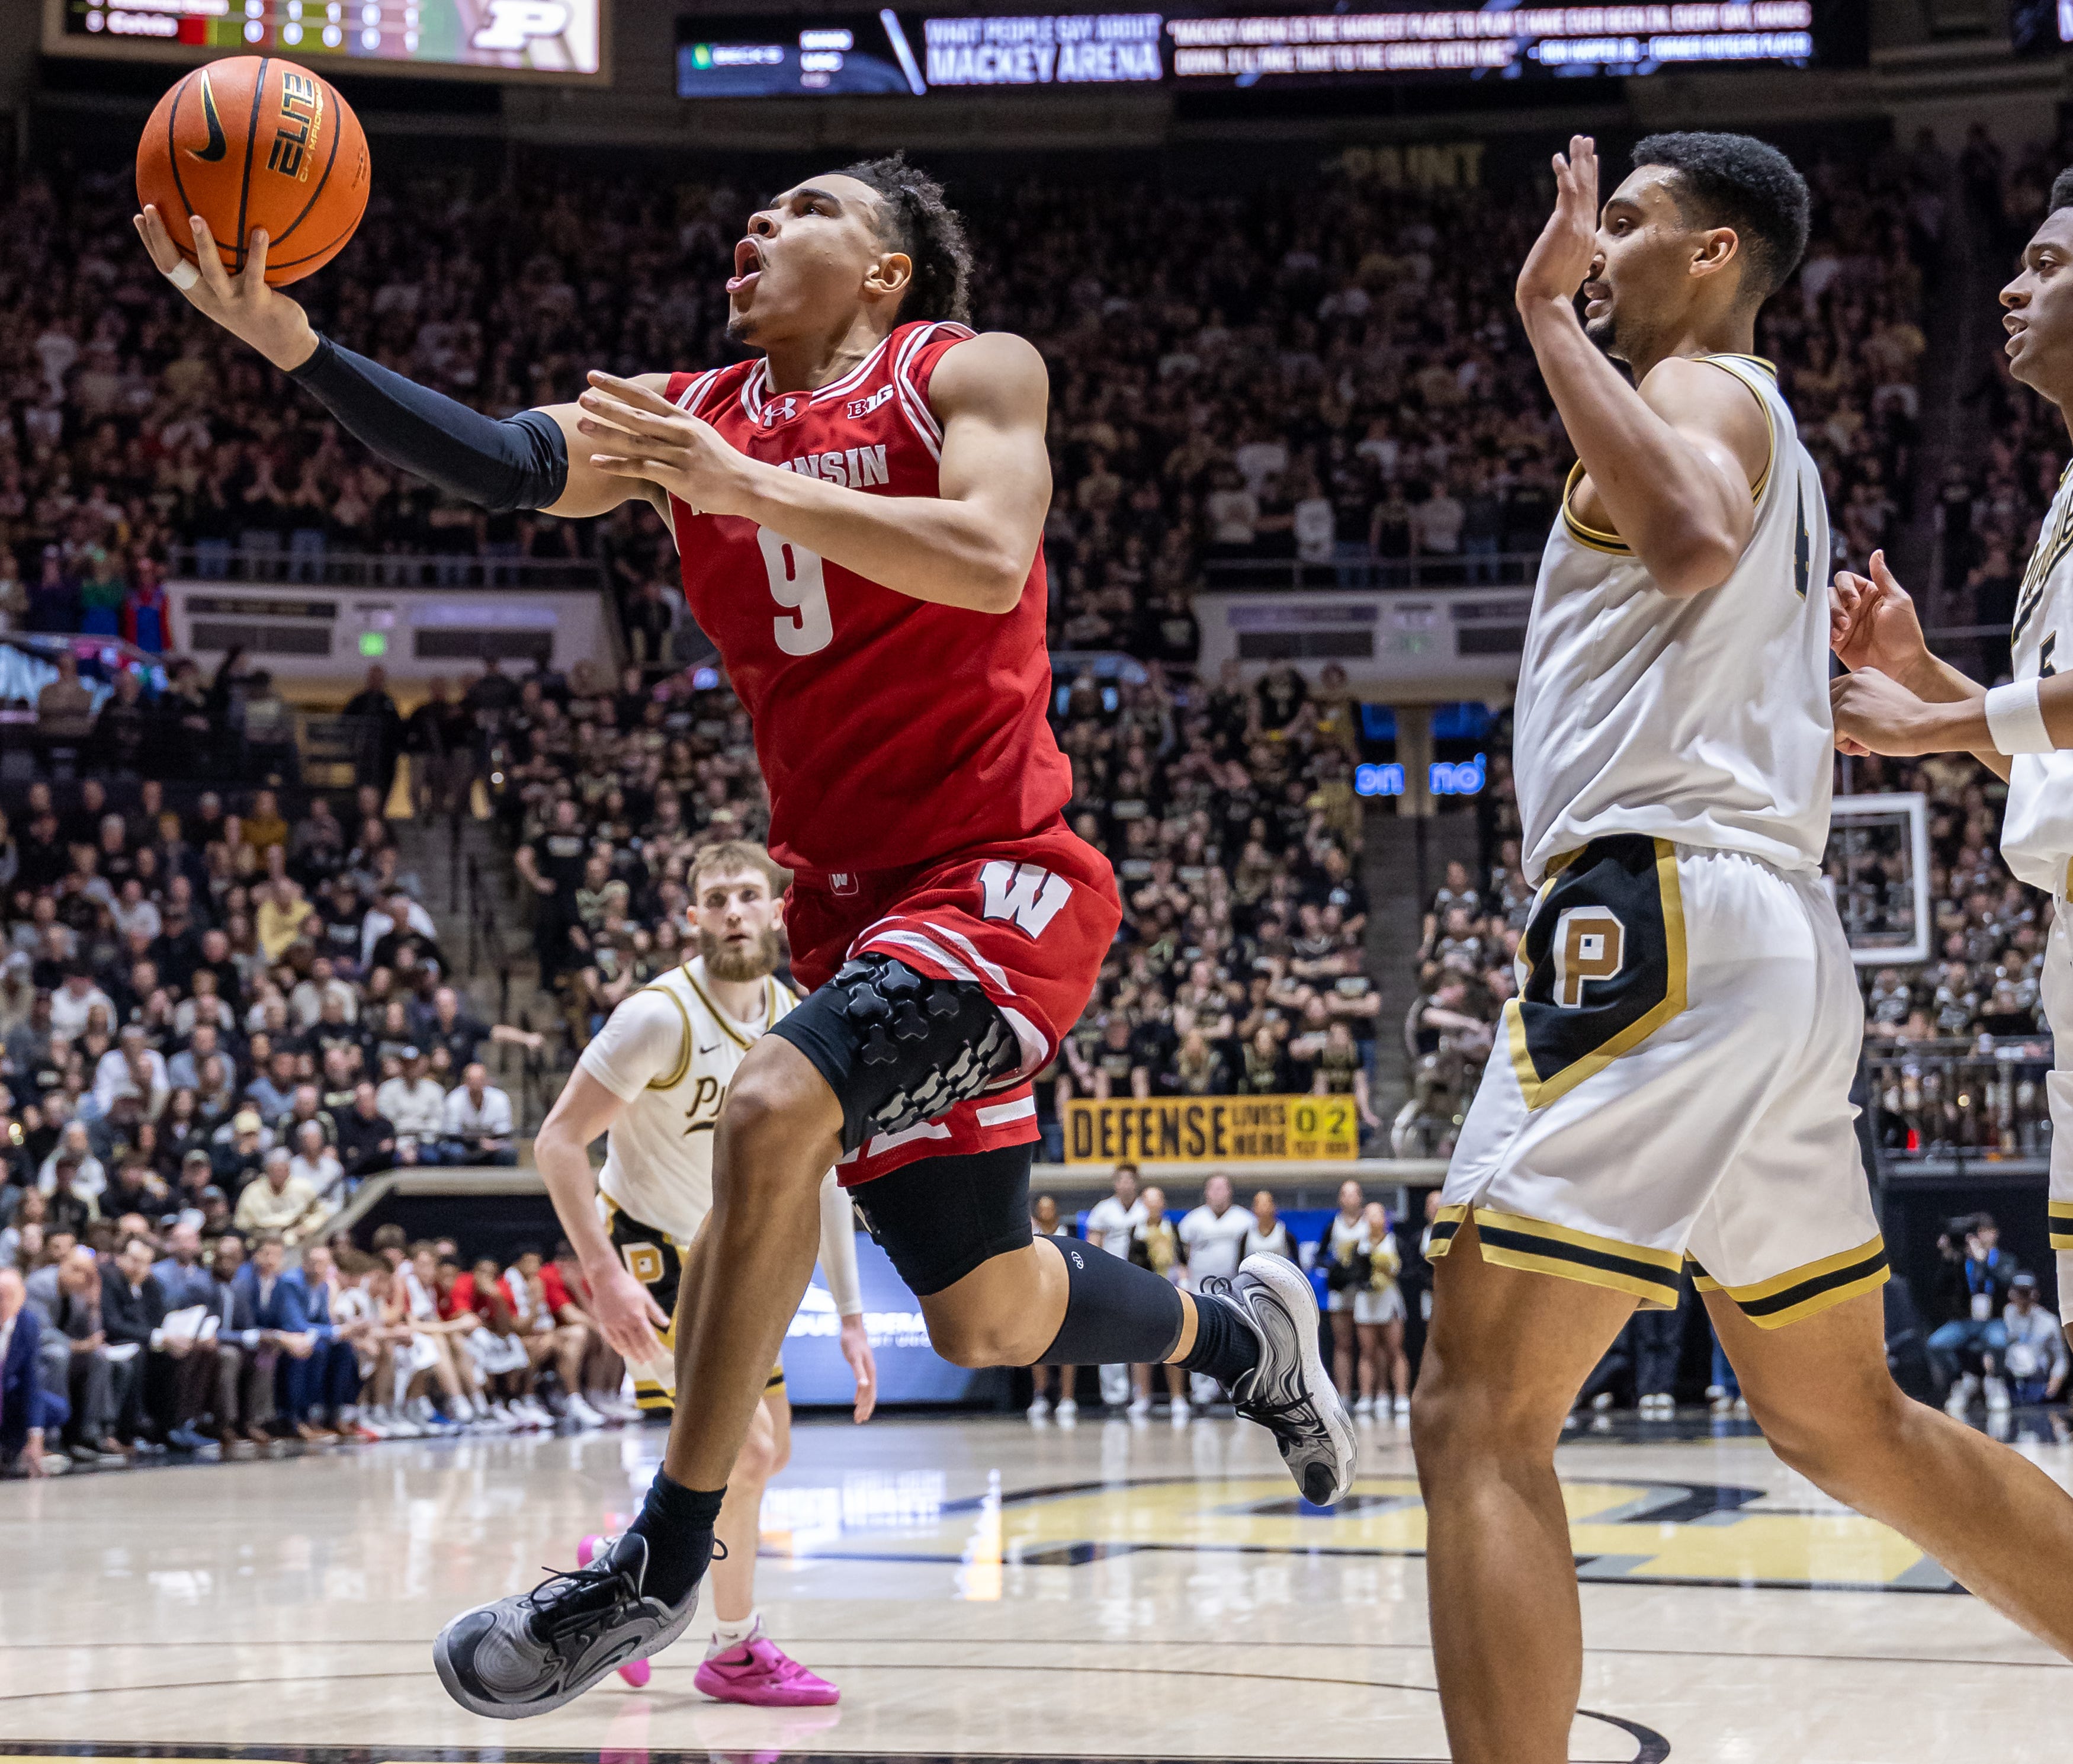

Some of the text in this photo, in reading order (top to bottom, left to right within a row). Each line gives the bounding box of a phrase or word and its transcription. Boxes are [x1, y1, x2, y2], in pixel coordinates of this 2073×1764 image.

[928, 42, 1162, 84] MACKEY ARENA
[266, 70, 316, 178] ELITE
[757, 525, 833, 656] 9
[978, 860, 1073, 939] W
[1553, 906, 1625, 1008] P
[1072, 1105, 1228, 1158] DEFENSE
